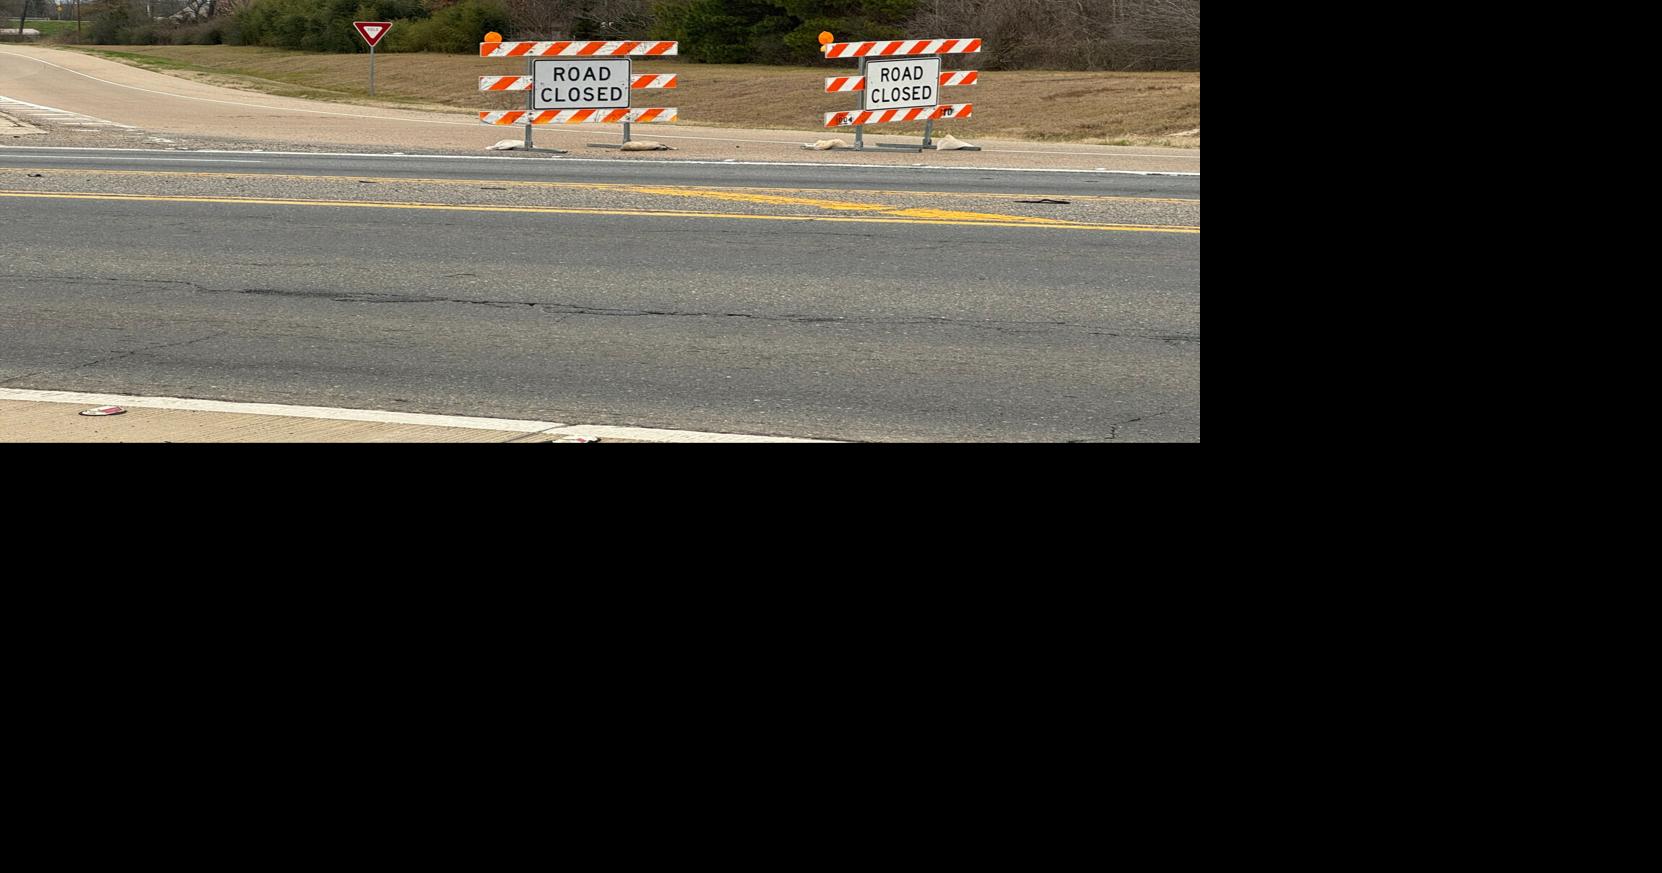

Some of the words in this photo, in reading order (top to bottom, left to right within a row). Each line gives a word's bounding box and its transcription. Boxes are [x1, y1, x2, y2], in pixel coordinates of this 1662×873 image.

[553, 66, 611, 82] ROAD
[880, 66, 924, 82] ROAD
[541, 87, 623, 102] CLOSED
[871, 85, 932, 103] CLOSED
